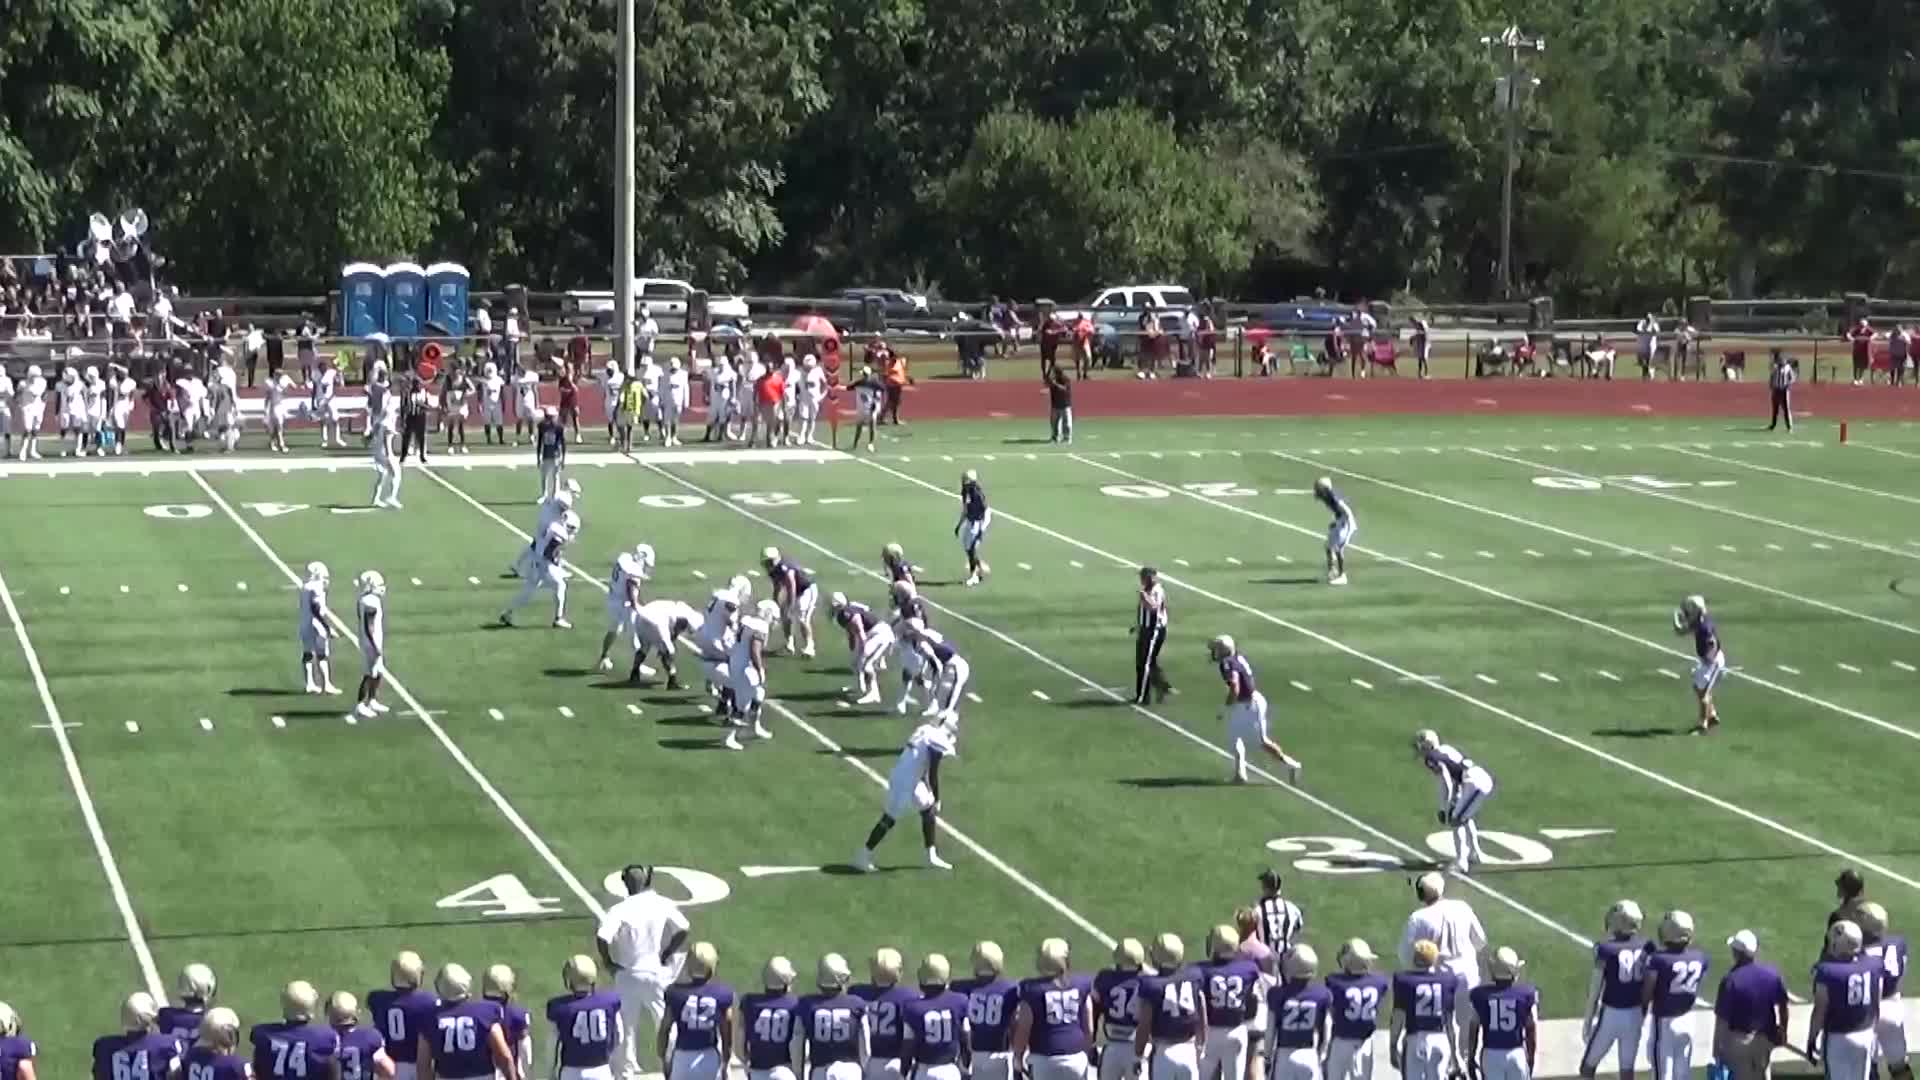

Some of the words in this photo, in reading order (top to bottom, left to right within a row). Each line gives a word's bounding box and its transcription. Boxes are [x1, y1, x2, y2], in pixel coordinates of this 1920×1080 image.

[1266, 830, 1553, 873] 30
[436, 865, 731, 915] 40
[1670, 961, 1703, 993] 22
[1864, 945, 1900, 977] 4
[1162, 980, 1196, 1017] 44
[1344, 986, 1378, 1021] 32
[1415, 983, 1443, 1016] 21
[1847, 971, 1872, 1005] 61
[387, 1008, 406, 1041] 0
[573, 1009, 607, 1044] 40
[754, 1008, 790, 1042] 48
[814, 1008, 851, 1042] 85
[923, 1010, 953, 1044] 91
[1281, 999, 1317, 1031] 23
[1488, 999, 1517, 1031] 15
[438, 1016, 476, 1053] 76
[111, 1050, 150, 1080] 64
[270, 1038, 307, 1077] 74
